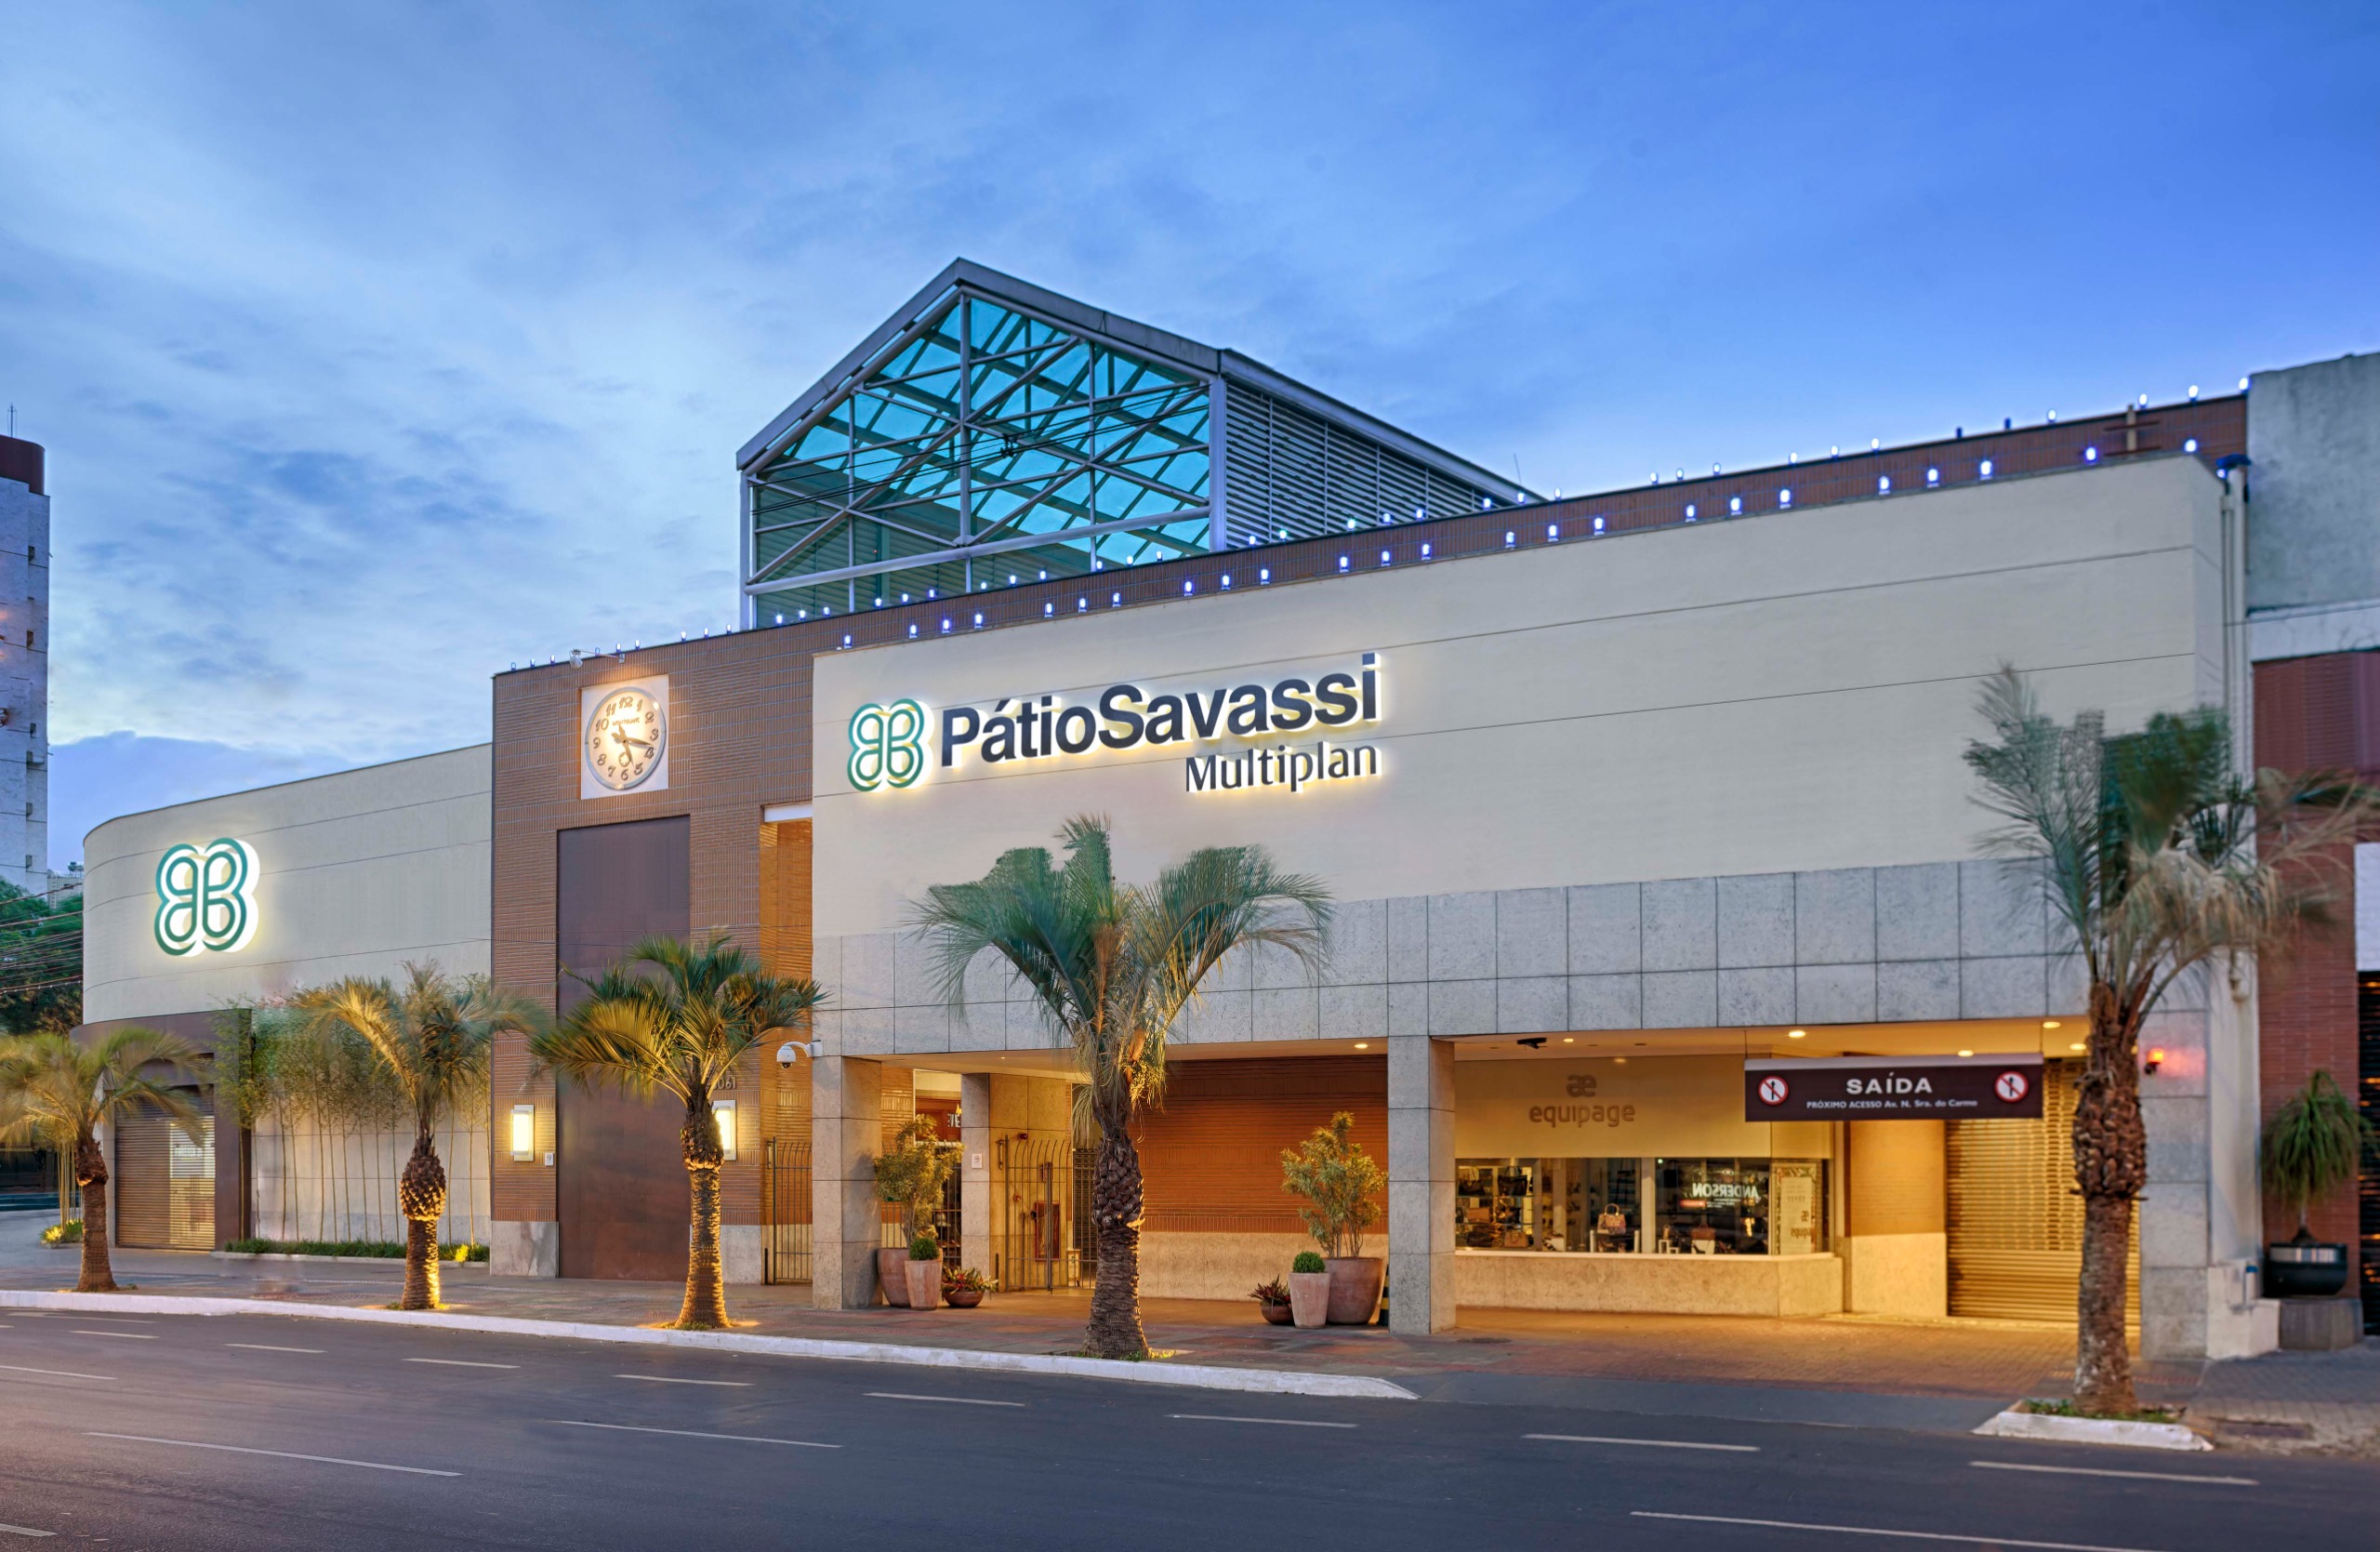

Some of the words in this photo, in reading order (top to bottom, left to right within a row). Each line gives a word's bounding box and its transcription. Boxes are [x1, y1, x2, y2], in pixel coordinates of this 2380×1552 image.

[619, 696, 633, 709] 12
[637, 699, 642, 711] 1
[606, 703, 616, 717] 11
[942, 653, 1377, 766] PátioSavassi
[645, 711, 654, 723] 2
[596, 718, 609, 732] 10
[650, 729, 658, 741] 3
[593, 737, 601, 749] 9
[644, 747, 654, 759] 4
[597, 754, 607, 766] 8
[608, 766, 615, 777] 7
[634, 763, 643, 776] 5
[1185, 741, 1377, 793] Multiplan
[621, 769, 628, 781] 6
[1846, 1072, 1933, 1094] SAÍDA
[1806, 1099, 1847, 1109] PRÓXIMO
[1848, 1100, 1883, 1108] ACESSO
[1529, 1104, 1636, 1128] equipage
